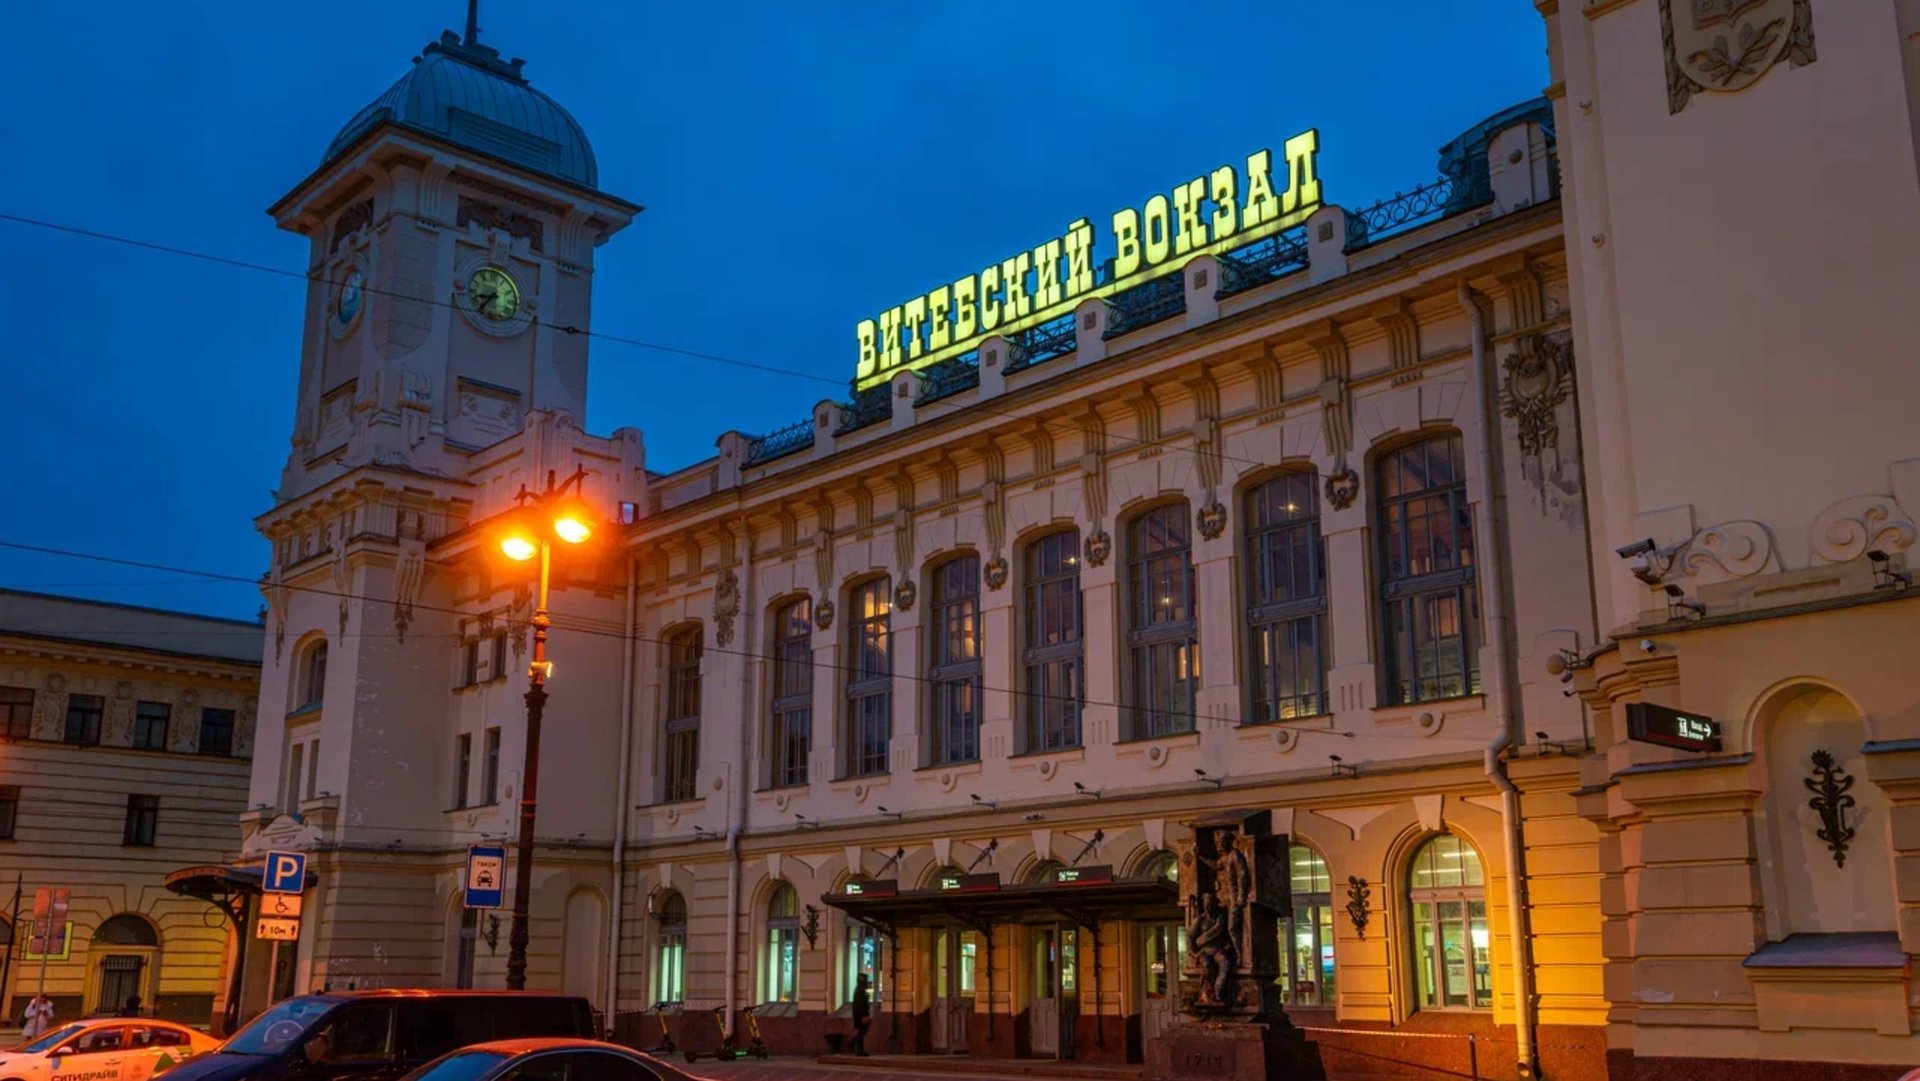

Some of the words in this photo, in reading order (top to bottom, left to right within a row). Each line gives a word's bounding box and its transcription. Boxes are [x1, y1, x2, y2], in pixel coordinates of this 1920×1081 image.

[856, 218, 1095, 379] ВИТЕБСКИЙ
[1112, 129, 1321, 279] ВОКЗАЛ
[274, 856, 298, 887] P
